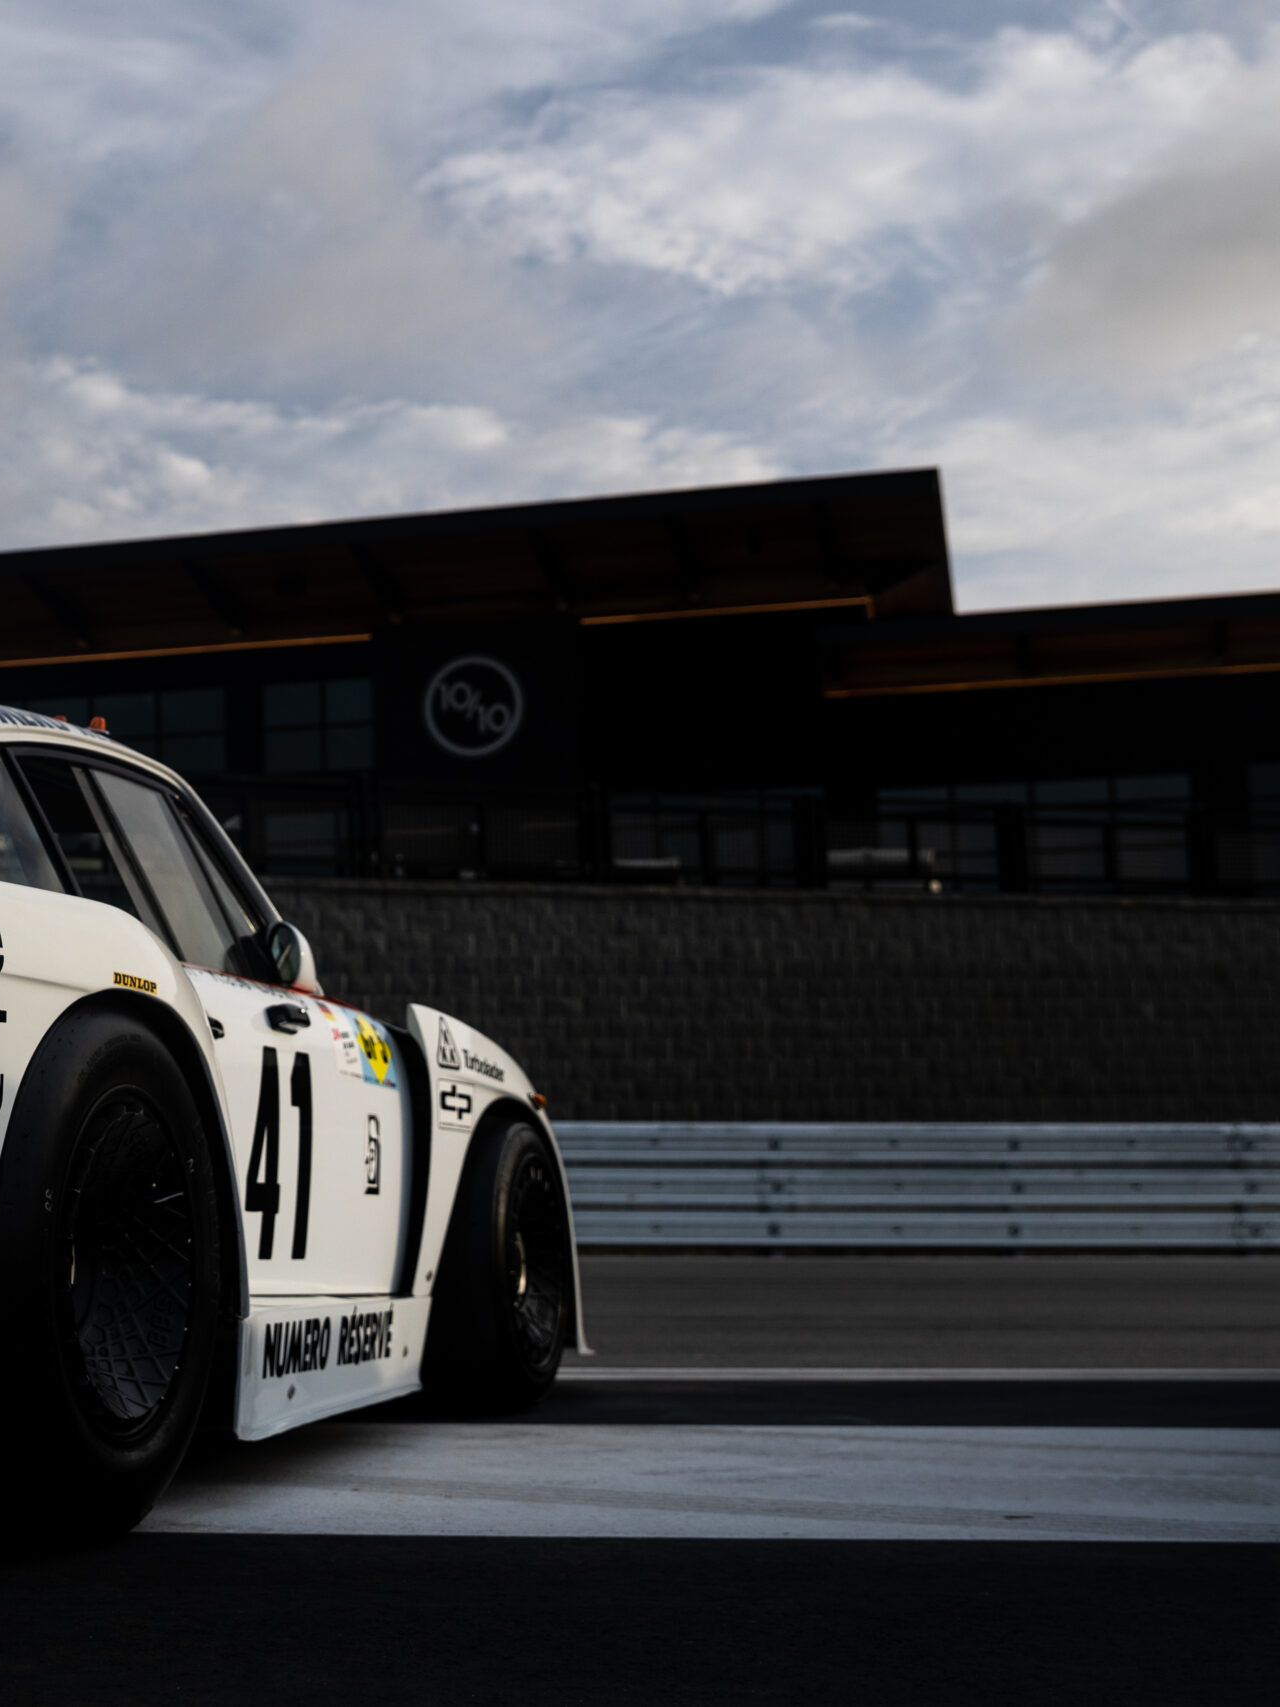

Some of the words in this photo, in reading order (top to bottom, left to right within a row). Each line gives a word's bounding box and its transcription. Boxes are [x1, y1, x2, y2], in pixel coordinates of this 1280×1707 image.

[438, 681, 511, 734] 10/10
[113, 971, 157, 993] DUNLOP
[246, 1046, 312, 1259] 41
[263, 1316, 330, 1379] NUMERO
